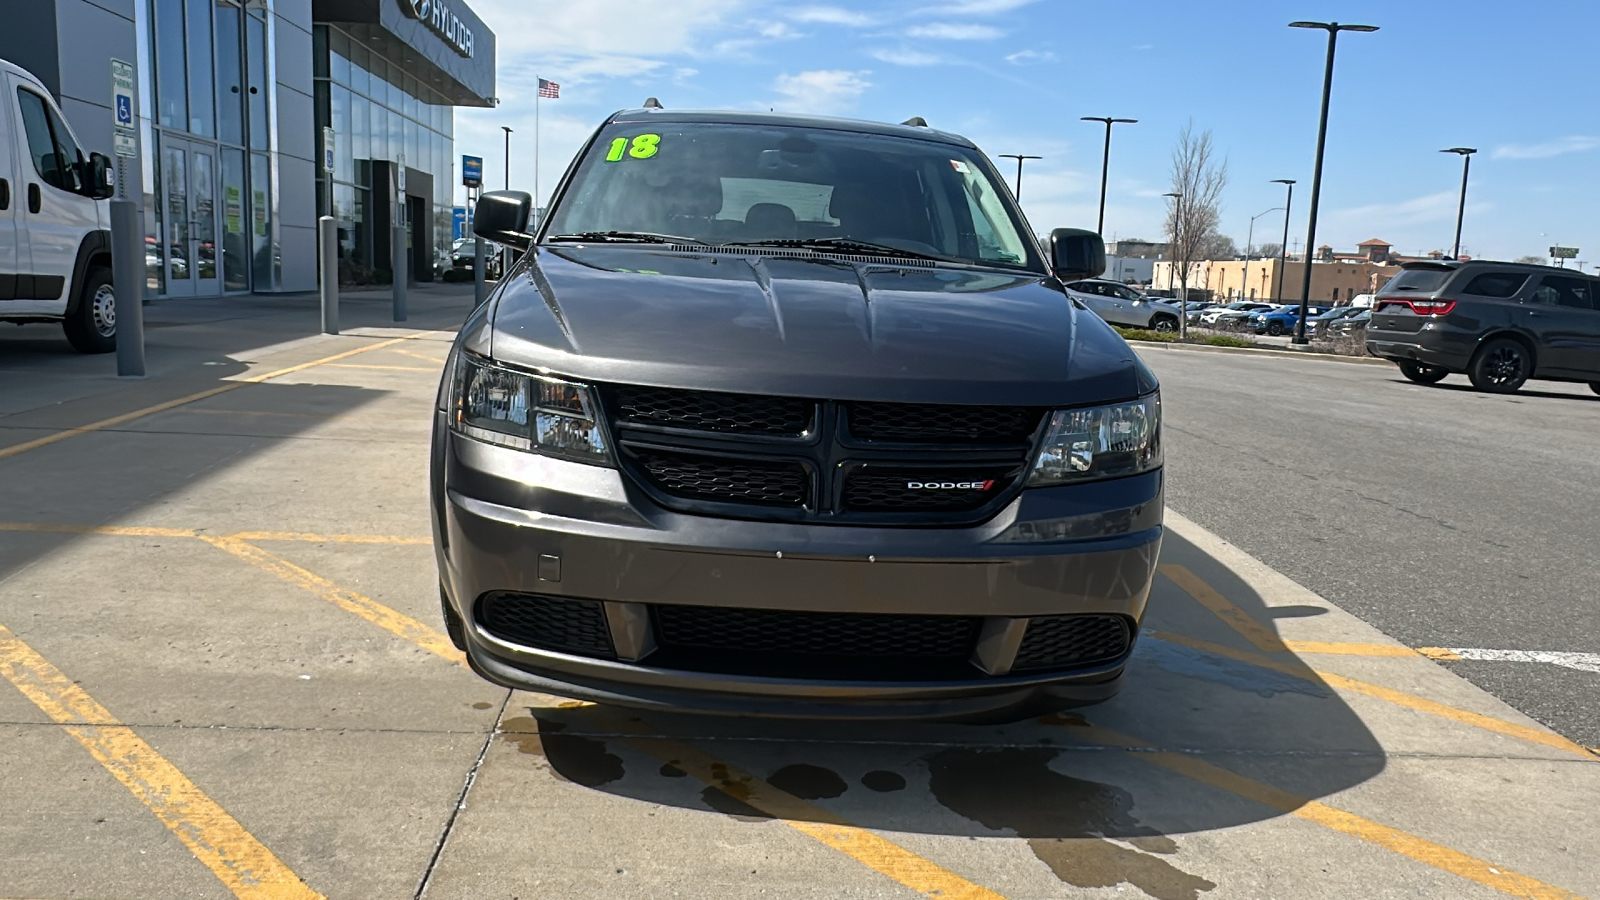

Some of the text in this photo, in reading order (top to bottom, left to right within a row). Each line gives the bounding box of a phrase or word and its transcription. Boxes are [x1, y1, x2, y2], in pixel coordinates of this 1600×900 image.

[432, 0, 474, 59] HYUNDAI
[606, 133, 661, 162] 18
[907, 481, 985, 489] DODGE
